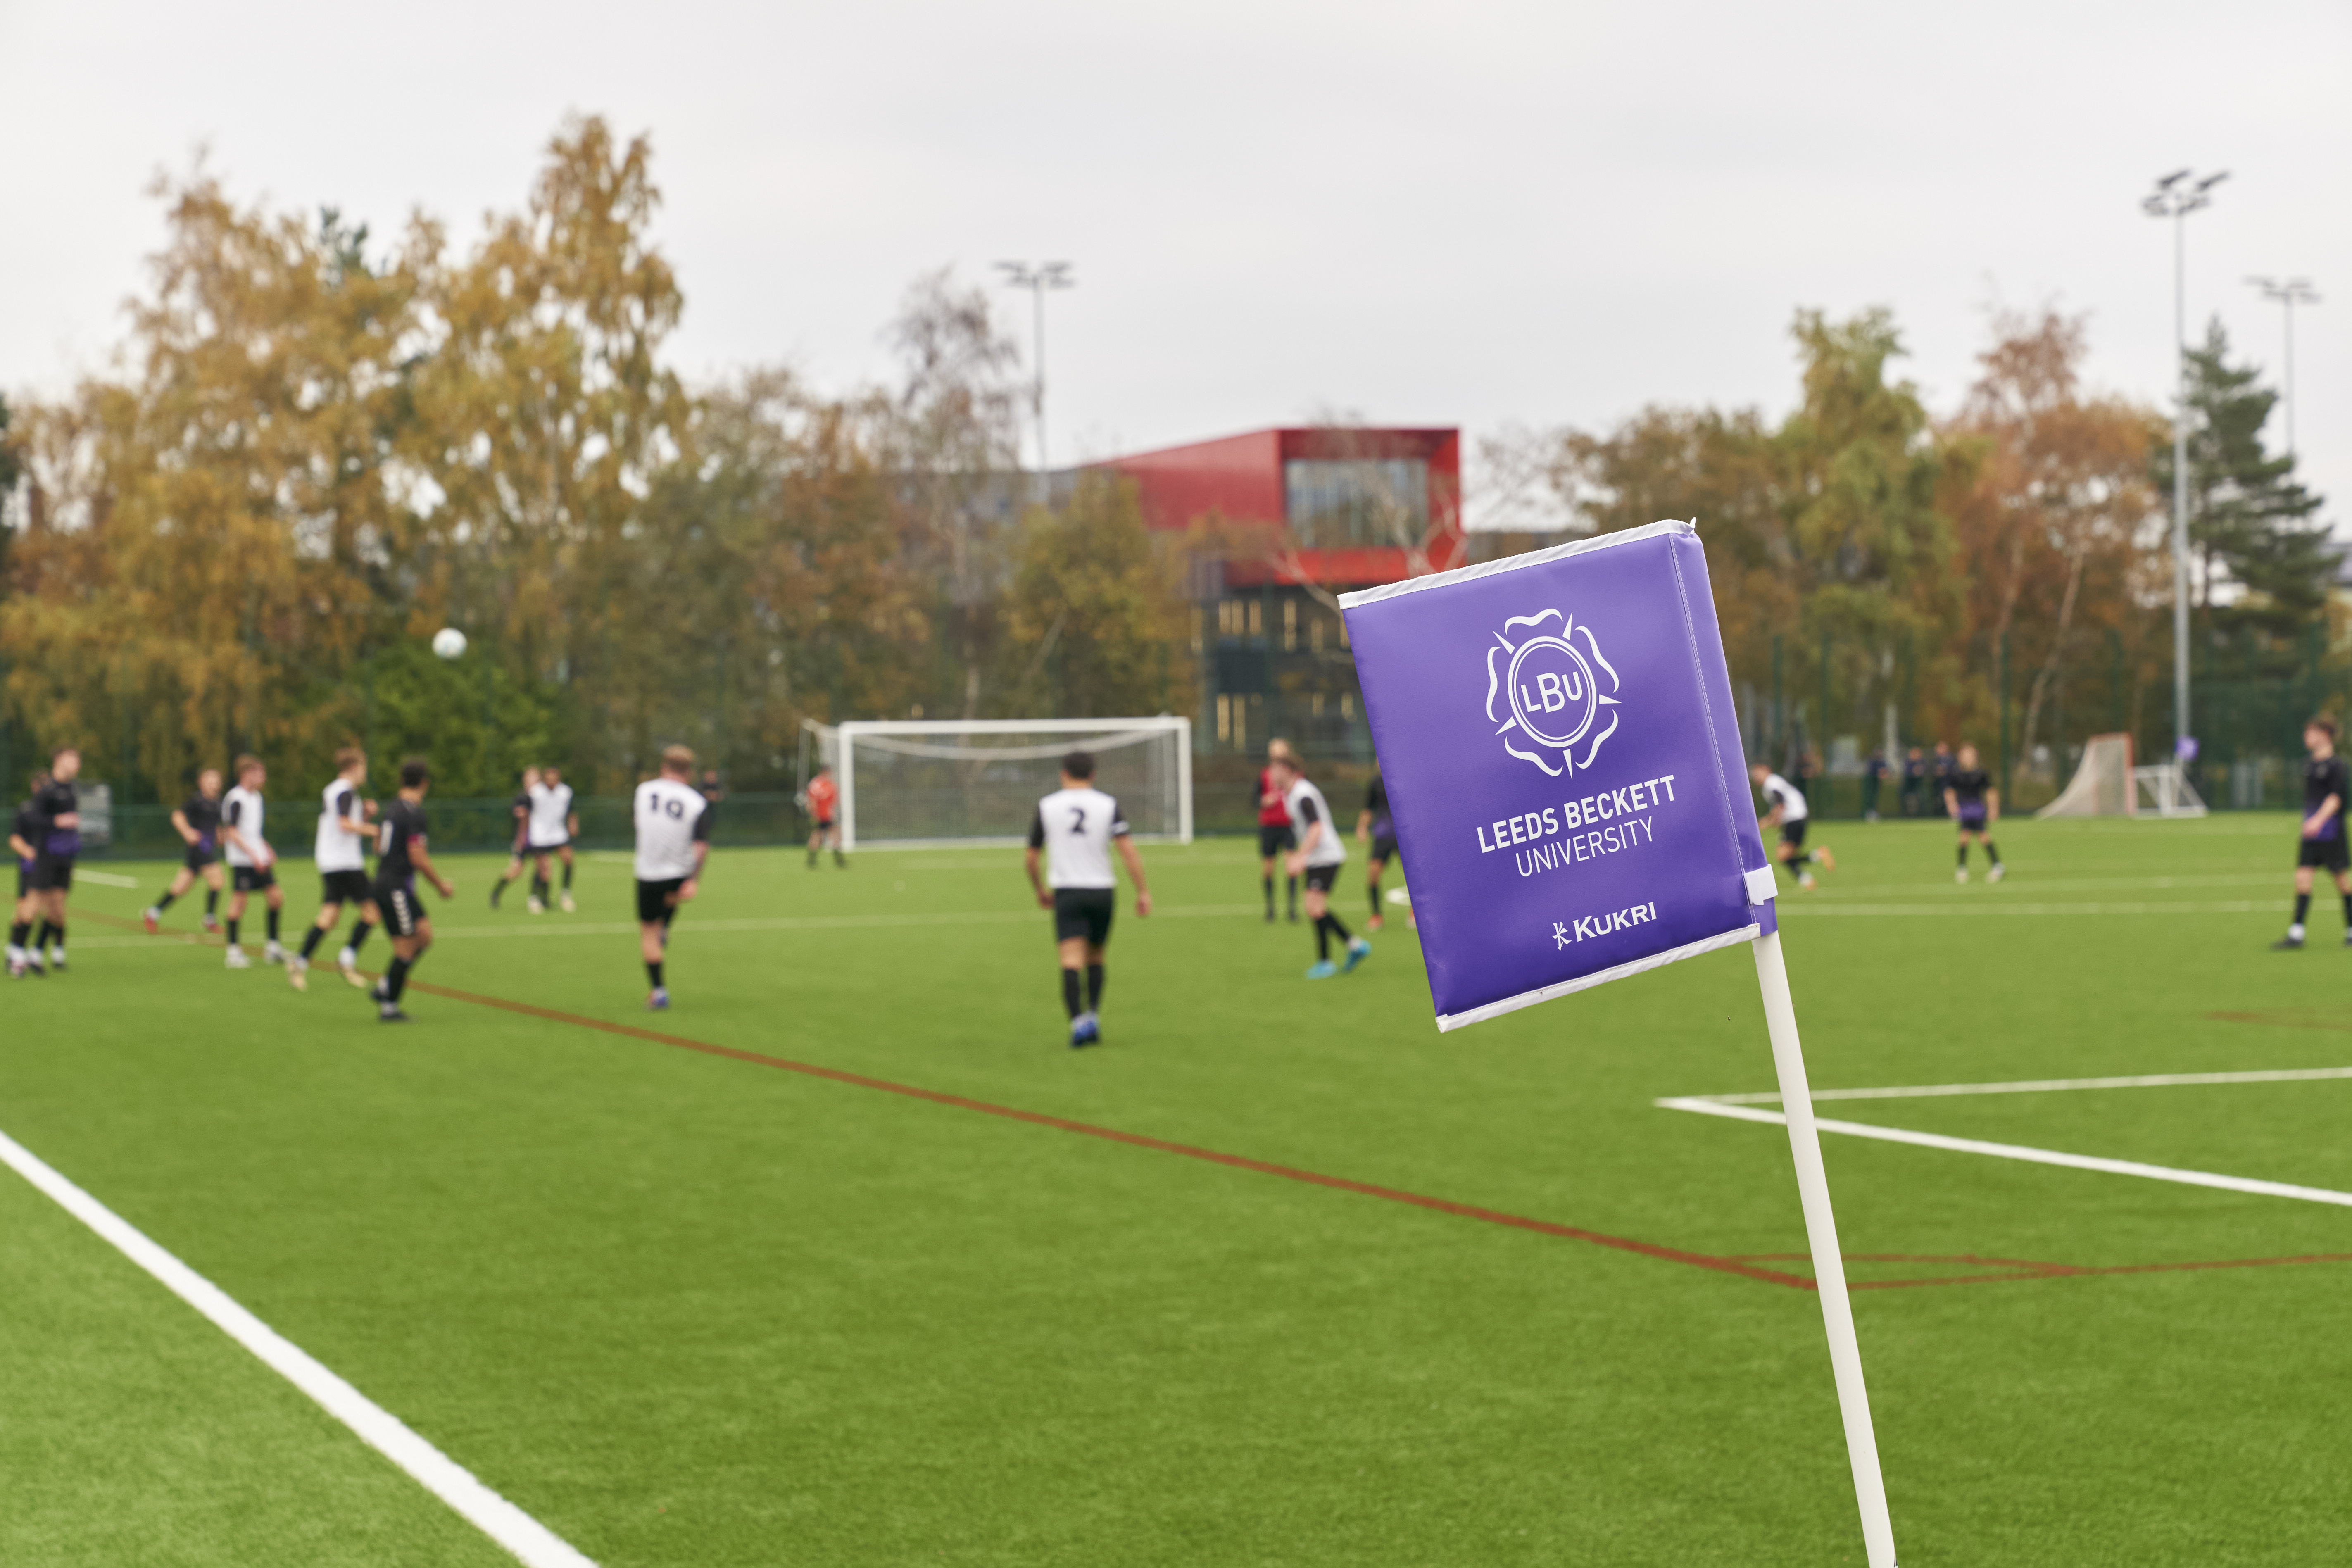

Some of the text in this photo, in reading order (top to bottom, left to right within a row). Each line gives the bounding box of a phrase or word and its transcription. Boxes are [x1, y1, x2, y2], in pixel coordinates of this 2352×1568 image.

[1521, 671, 1582, 713] LBU
[1069, 807, 1087, 835] 2
[1477, 775, 1674, 853] LEEDS BECKETT
[1516, 816, 1652, 876] UNIVERSITY
[1573, 902, 1657, 942] KUKRI
